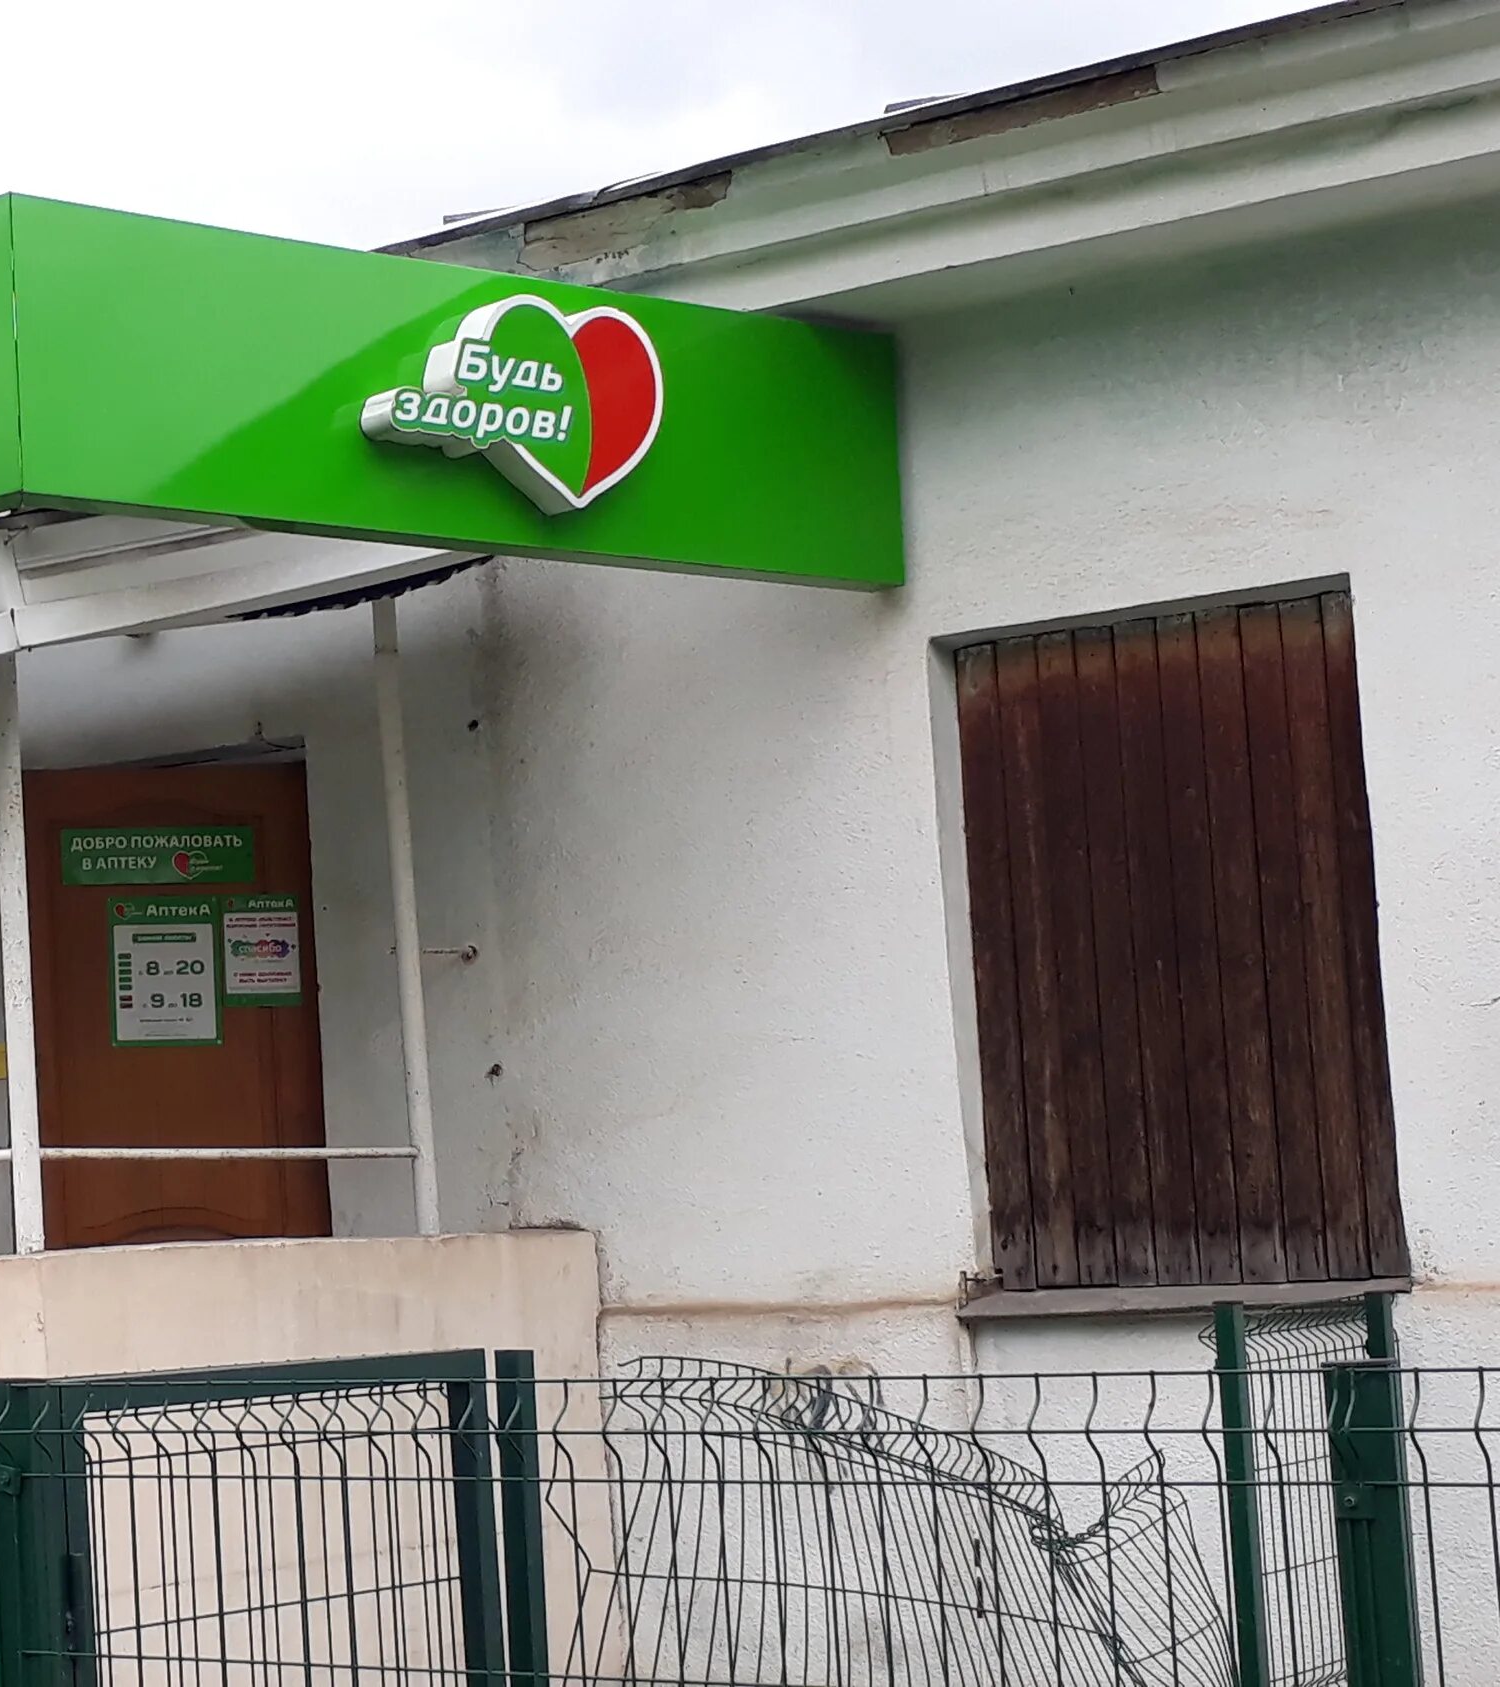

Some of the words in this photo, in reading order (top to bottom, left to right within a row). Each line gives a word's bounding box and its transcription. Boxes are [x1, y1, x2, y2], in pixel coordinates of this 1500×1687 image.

[457, 343, 564, 394] Будь
[70, 836, 127, 852] ДОБРО
[130, 834, 243, 849] ПОЖАЛОВАТЬ
[82, 857, 92, 870] В
[96, 855, 157, 870] АПТЕКУ
[146, 961, 160, 976] 8
[176, 960, 205, 975] 20
[150, 994, 165, 1008] 9
[180, 993, 203, 1008] 18
